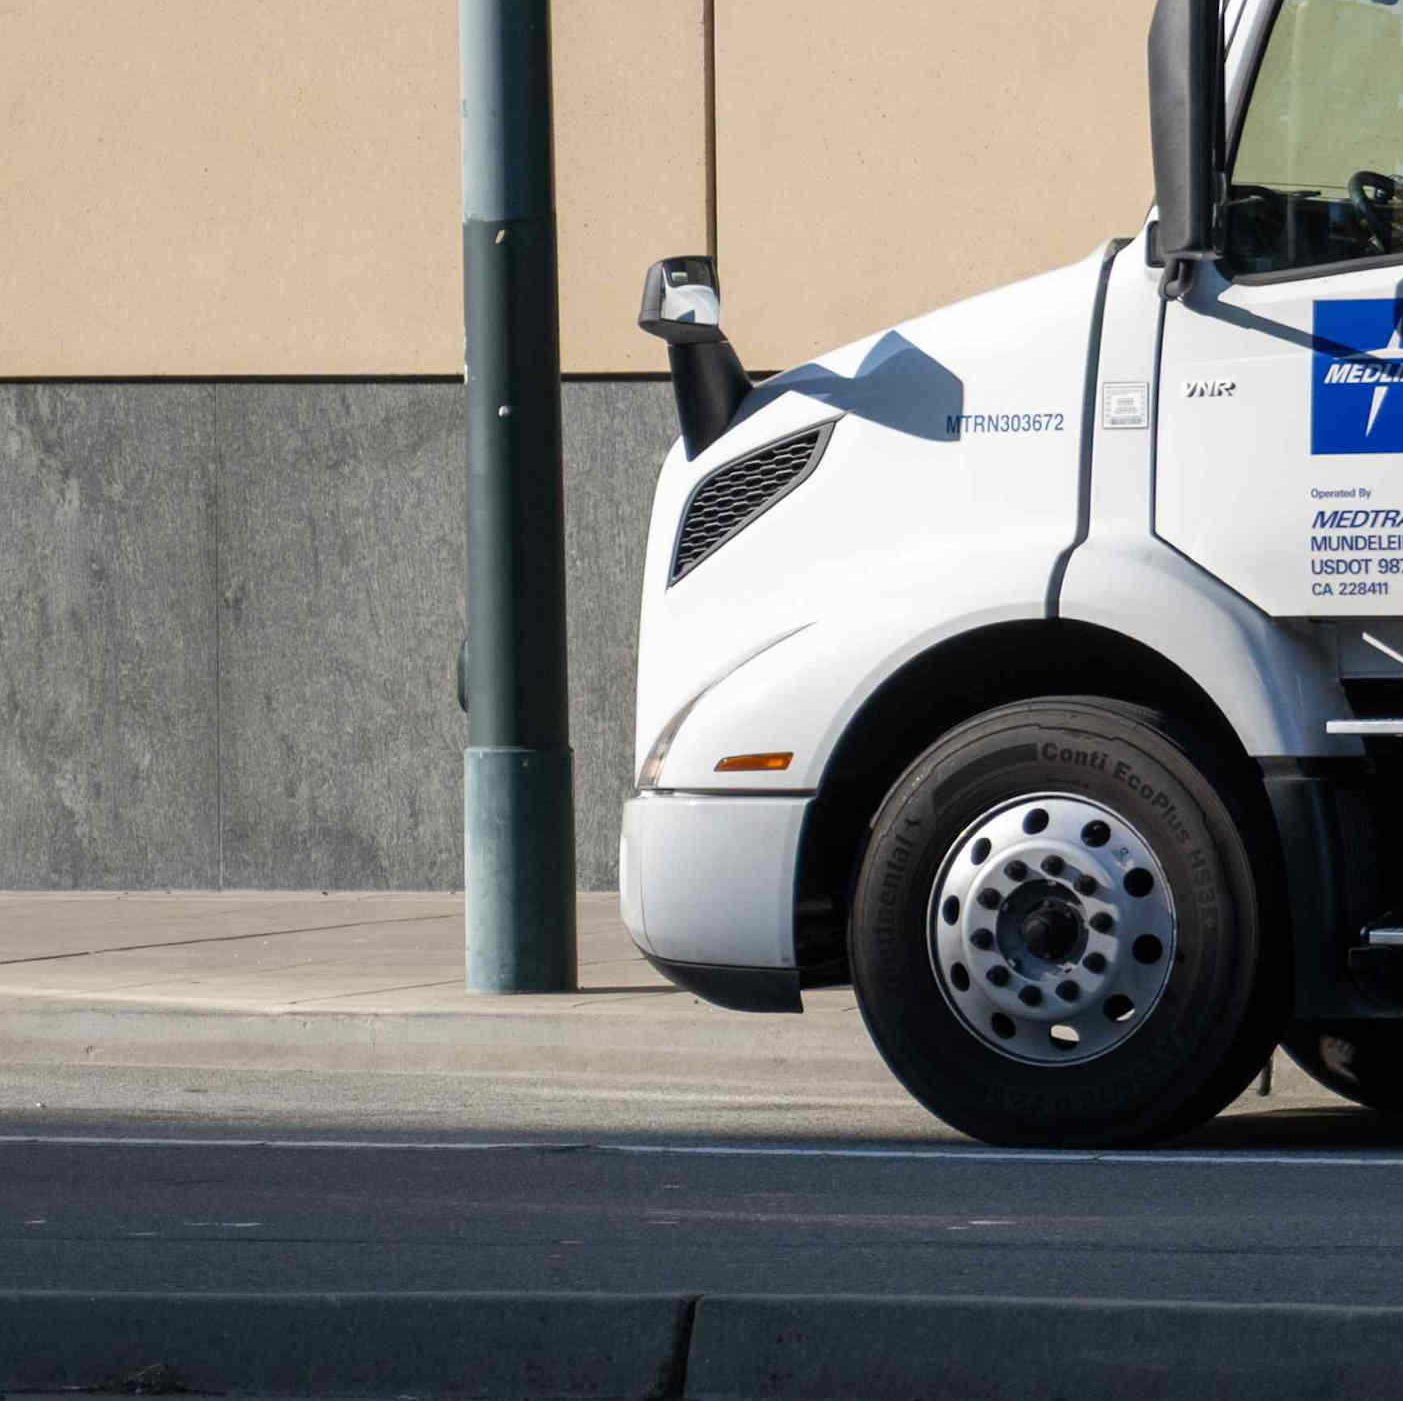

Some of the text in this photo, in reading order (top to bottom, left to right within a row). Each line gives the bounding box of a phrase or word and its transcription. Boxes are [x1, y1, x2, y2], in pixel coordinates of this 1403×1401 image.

[1184, 379, 1236, 397] VNR
[946, 413, 1065, 435] MTRN303672
[1310, 488, 1372, 499] Operated By
[1311, 558, 1372, 575] USDOT
[1311, 581, 1389, 596] CA 228411
[1041, 742, 1109, 770] Conti
[1113, 760, 1191, 844] EcoPlus
